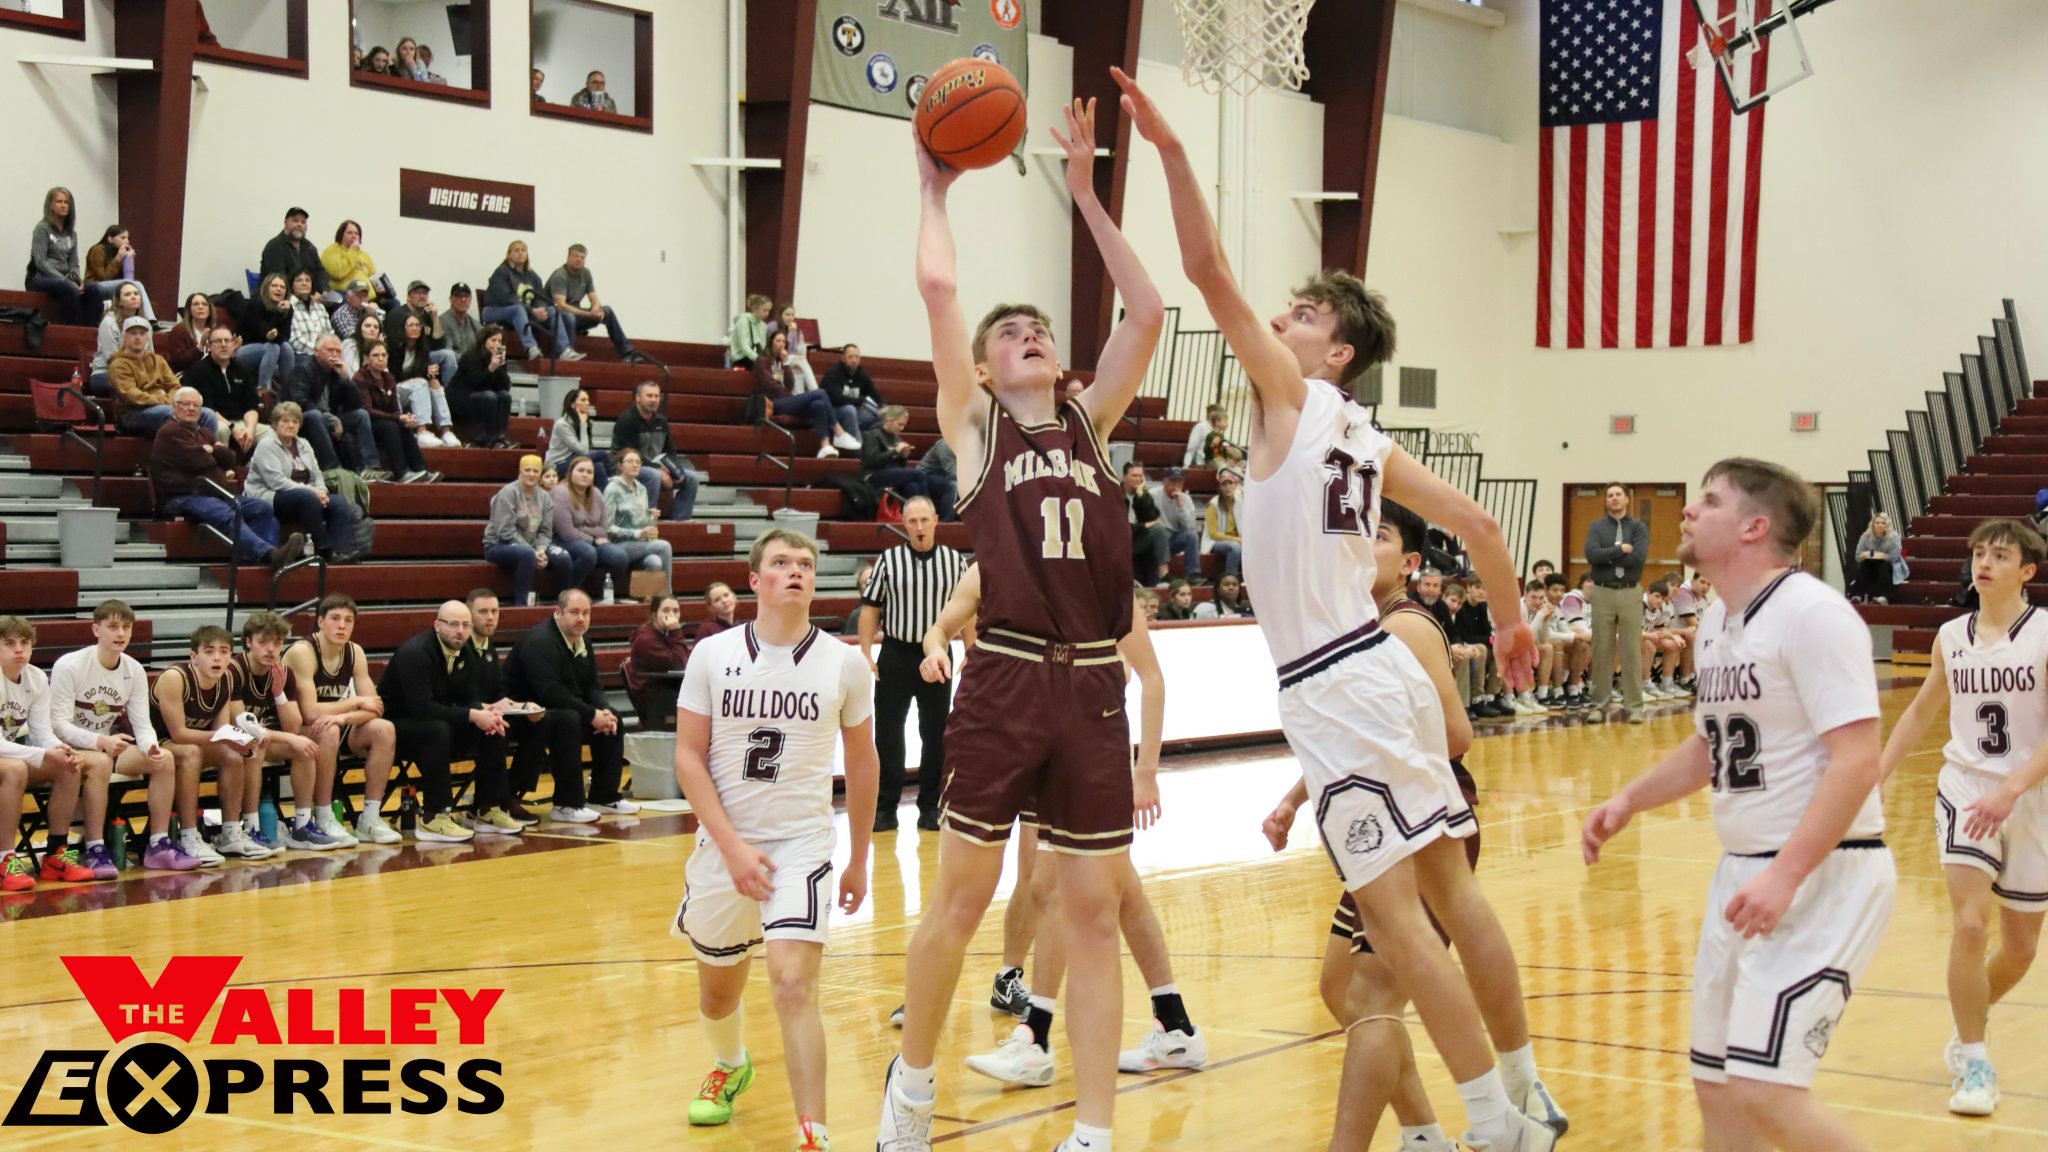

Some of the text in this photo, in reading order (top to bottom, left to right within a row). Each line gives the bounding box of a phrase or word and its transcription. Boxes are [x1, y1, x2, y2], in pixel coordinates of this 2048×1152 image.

[429, 187, 511, 214] VISITING FANS
[1041, 497, 1086, 559] 11
[84, 685, 122, 704] DO MORE
[1698, 663, 1761, 703] ULLDOGS
[1953, 666, 2035, 694] BULLDOGS
[76, 712, 94, 729] SAY
[722, 689, 819, 721] BULLDOGS
[1976, 701, 2011, 758] 3
[742, 726, 786, 783] 2
